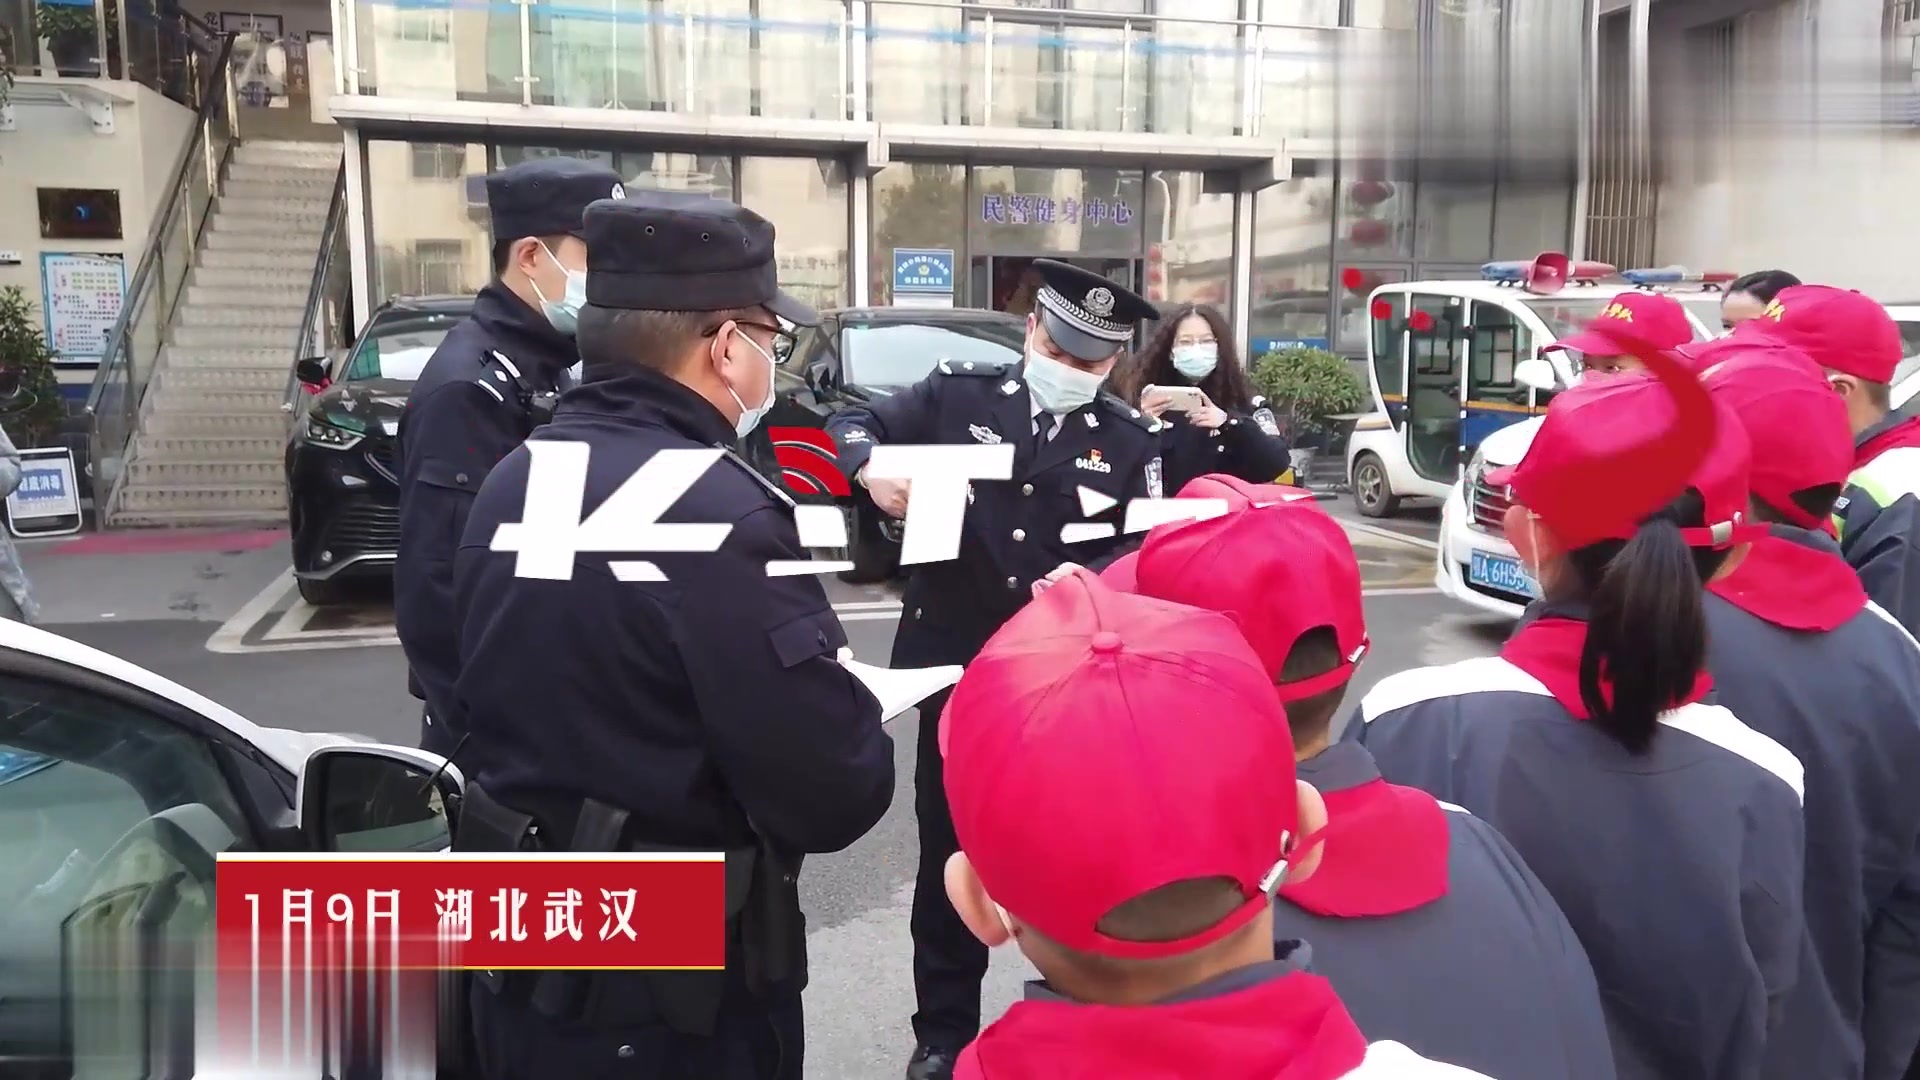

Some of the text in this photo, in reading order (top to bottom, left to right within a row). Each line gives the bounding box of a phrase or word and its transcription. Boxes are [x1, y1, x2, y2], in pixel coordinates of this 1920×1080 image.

[982, 194, 1133, 226] 民警健身中心
[1075, 457, 1112, 474] 041229
